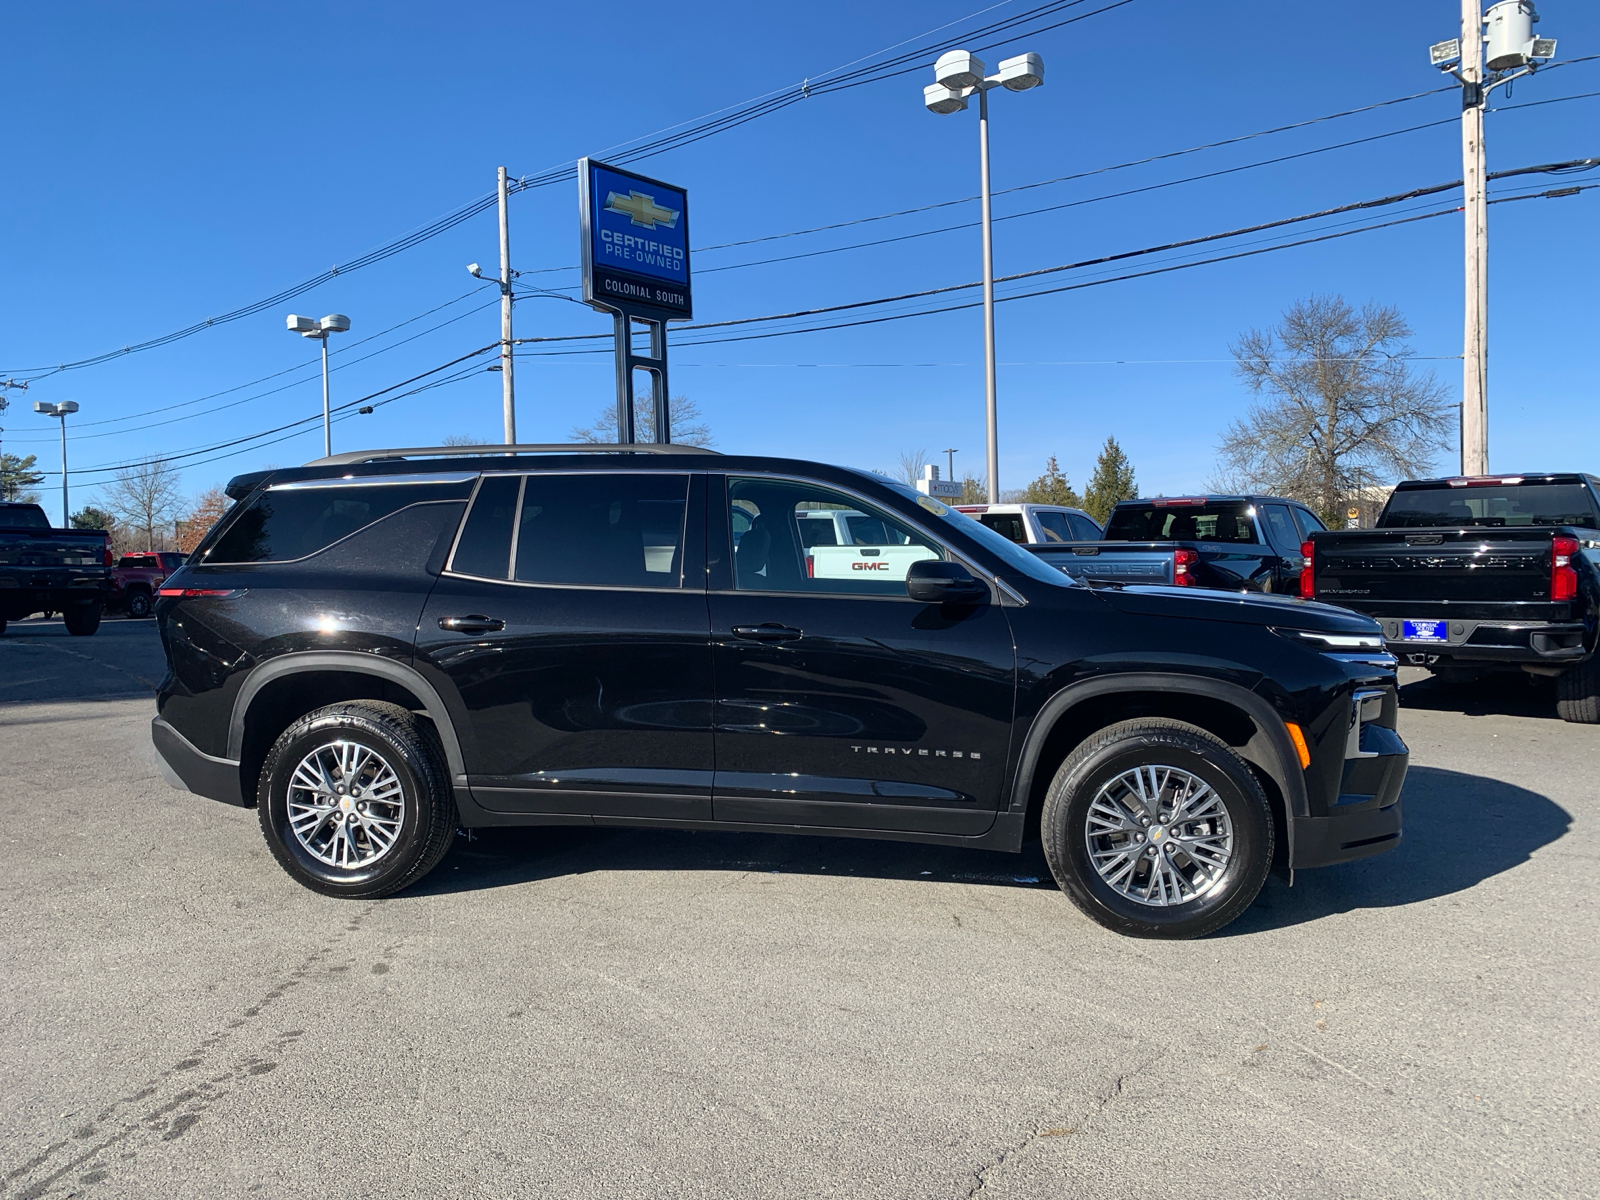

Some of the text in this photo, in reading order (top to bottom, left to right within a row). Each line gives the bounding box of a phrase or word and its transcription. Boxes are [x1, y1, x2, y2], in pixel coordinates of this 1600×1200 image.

[600, 229, 684, 260] CERTIFIED
[605, 243, 681, 271] PRE-OWNED
[605, 278, 684, 306] COLONIAL SOUTH
[851, 562, 889, 571] GMC
[850, 745, 981, 759] TRAVERSE
